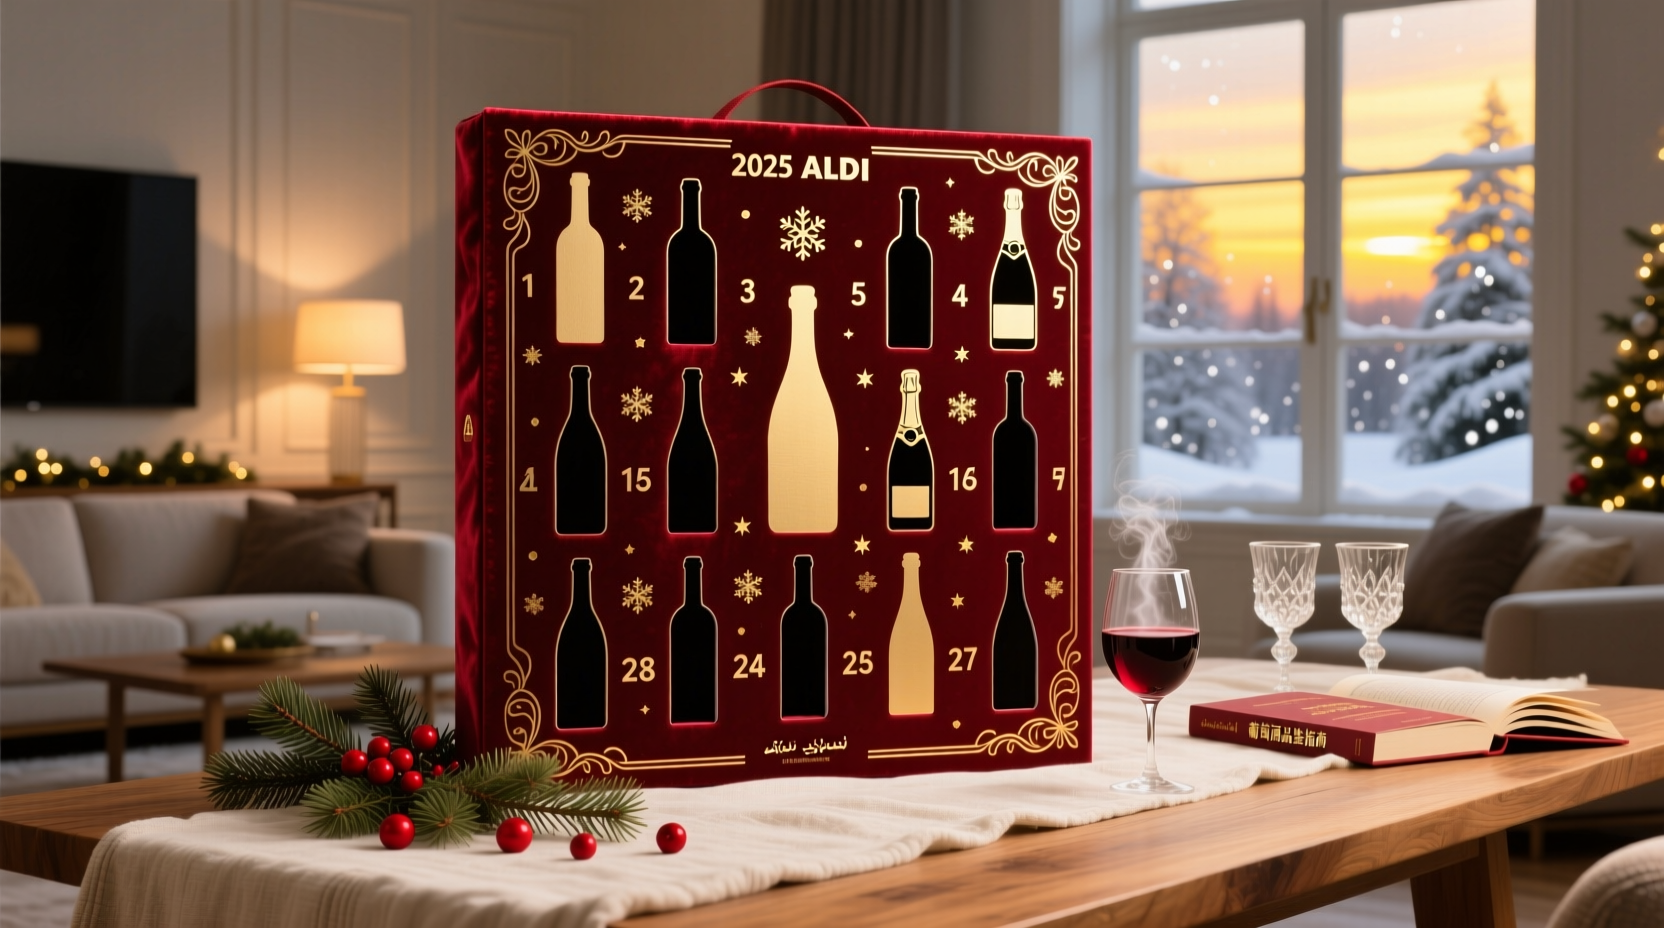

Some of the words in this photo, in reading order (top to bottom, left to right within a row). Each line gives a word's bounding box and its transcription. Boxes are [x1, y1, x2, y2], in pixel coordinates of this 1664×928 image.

[731, 153, 793, 179] 2025
[801, 154, 870, 181] ALDI
[522, 274, 532, 297] 1
[629, 276, 644, 300] 2
[740, 279, 755, 303] 3
[851, 282, 866, 306] 5
[952, 284, 968, 307] 4
[1053, 286, 1066, 309] 5
[622, 467, 651, 492] 15
[949, 467, 977, 491] 16
[622, 657, 655, 682] 28
[733, 654, 765, 678] 24
[843, 651, 873, 675] 25
[949, 647, 977, 671] 27
